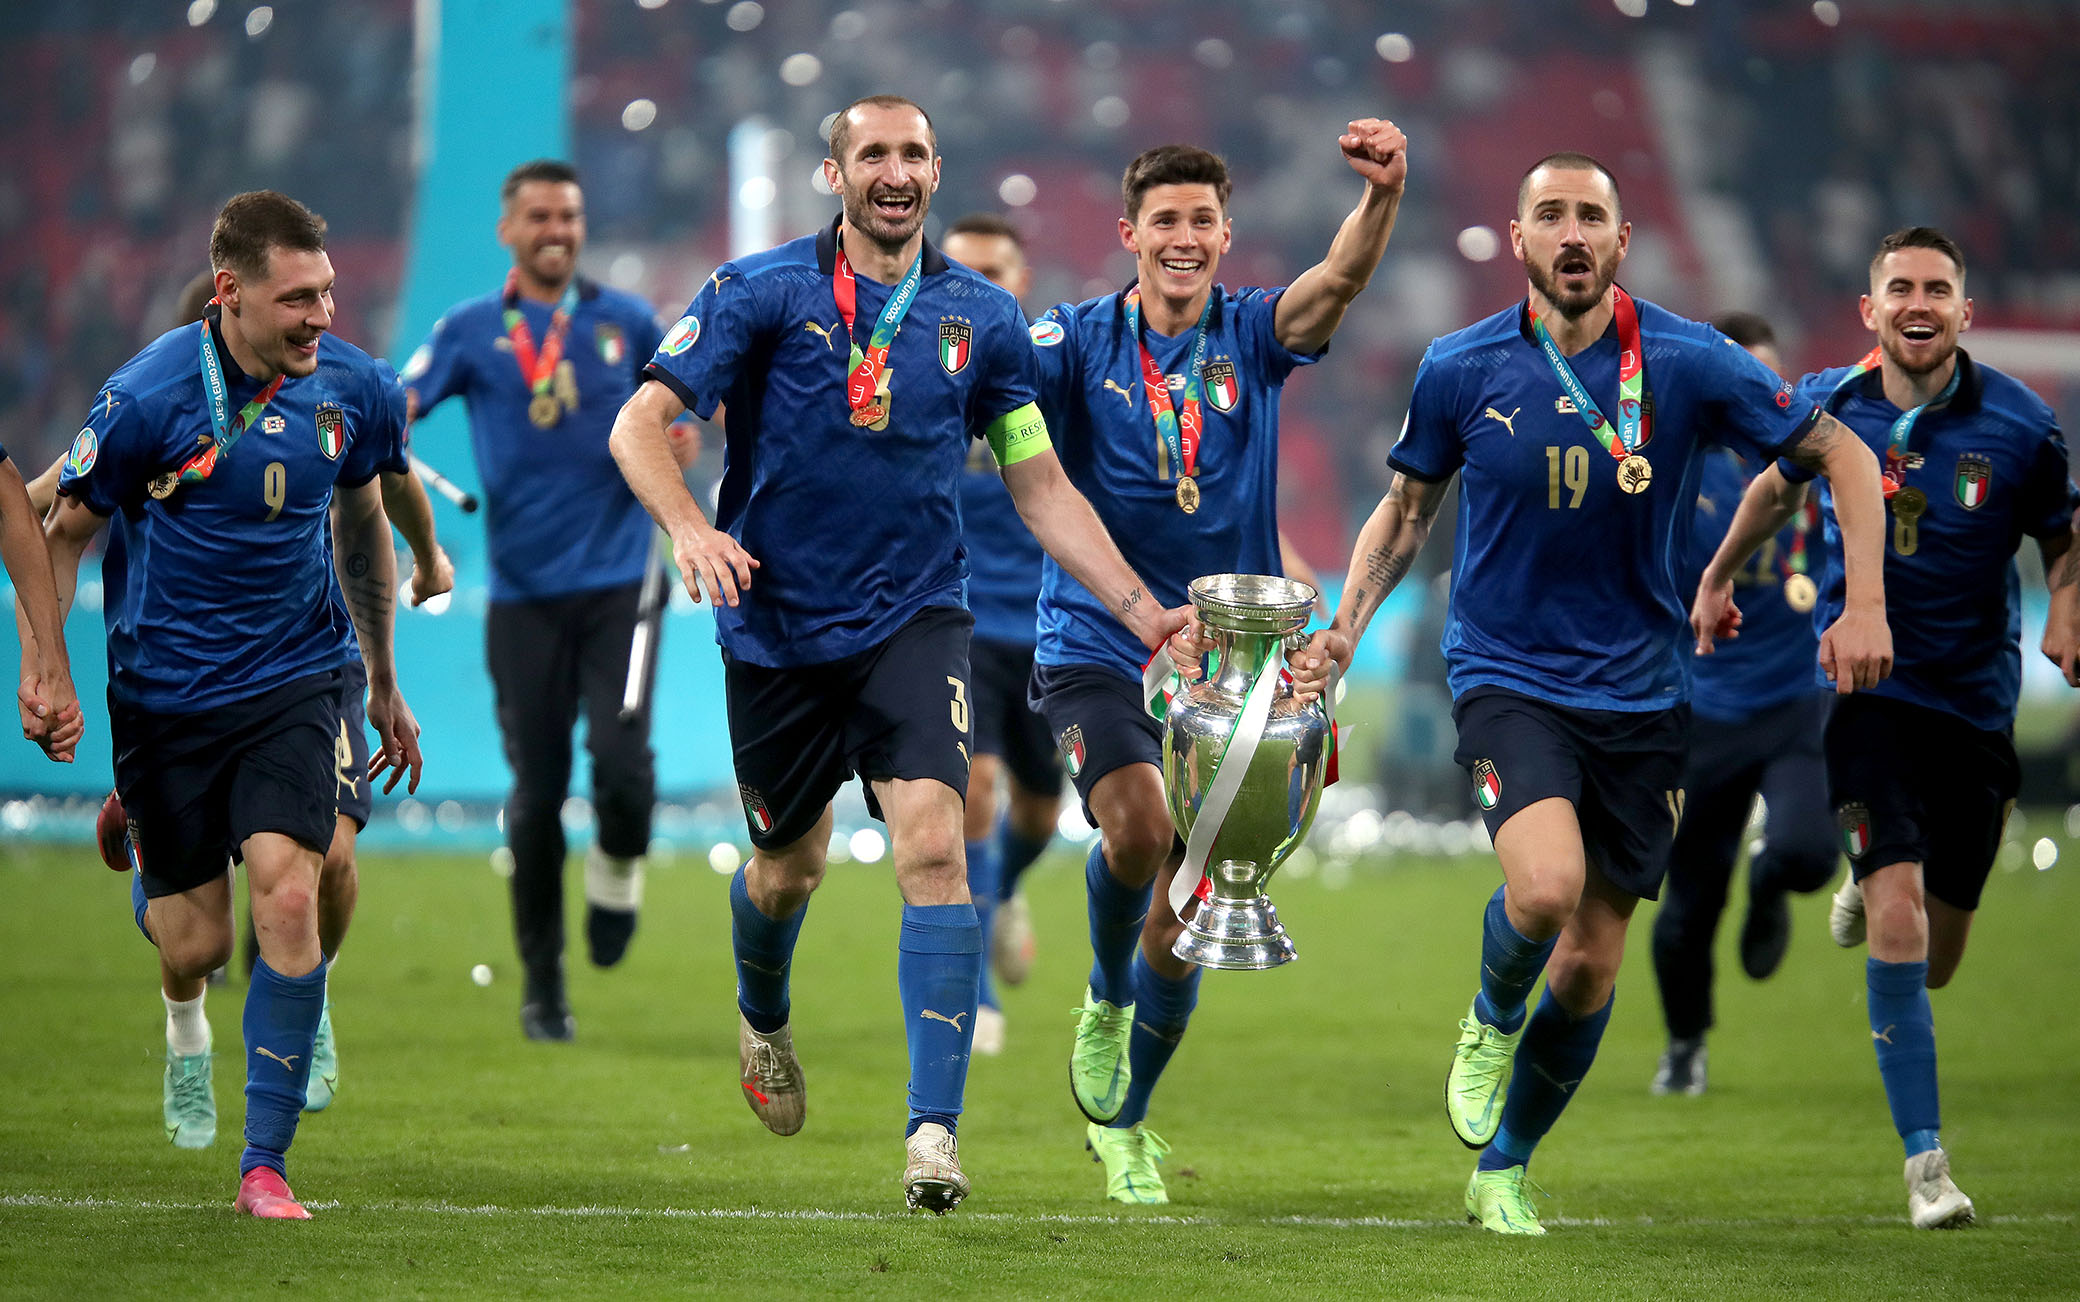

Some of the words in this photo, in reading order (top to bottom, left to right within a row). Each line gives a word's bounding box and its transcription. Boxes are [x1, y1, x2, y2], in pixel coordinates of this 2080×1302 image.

[896, 278, 915, 304] EURO
[884, 301, 901, 324] 2020
[941, 326, 969, 337] ITALIA
[203, 343, 216, 369] 2020
[1192, 352, 1202, 377] 2020
[1544, 341, 1559, 365] 2020
[209, 368, 221, 394] EURO
[1203, 366, 1232, 378] ITALIA
[1556, 361, 1573, 387] EURO
[215, 394, 225, 421] UEFA
[1571, 383, 1588, 409] UEFA
[318, 412, 341, 424] ITALIA
[1624, 422, 1633, 447] UEFA
[1546, 445, 1590, 509] 19
[264, 462, 286, 522] 9
[946, 675, 969, 733] 3
